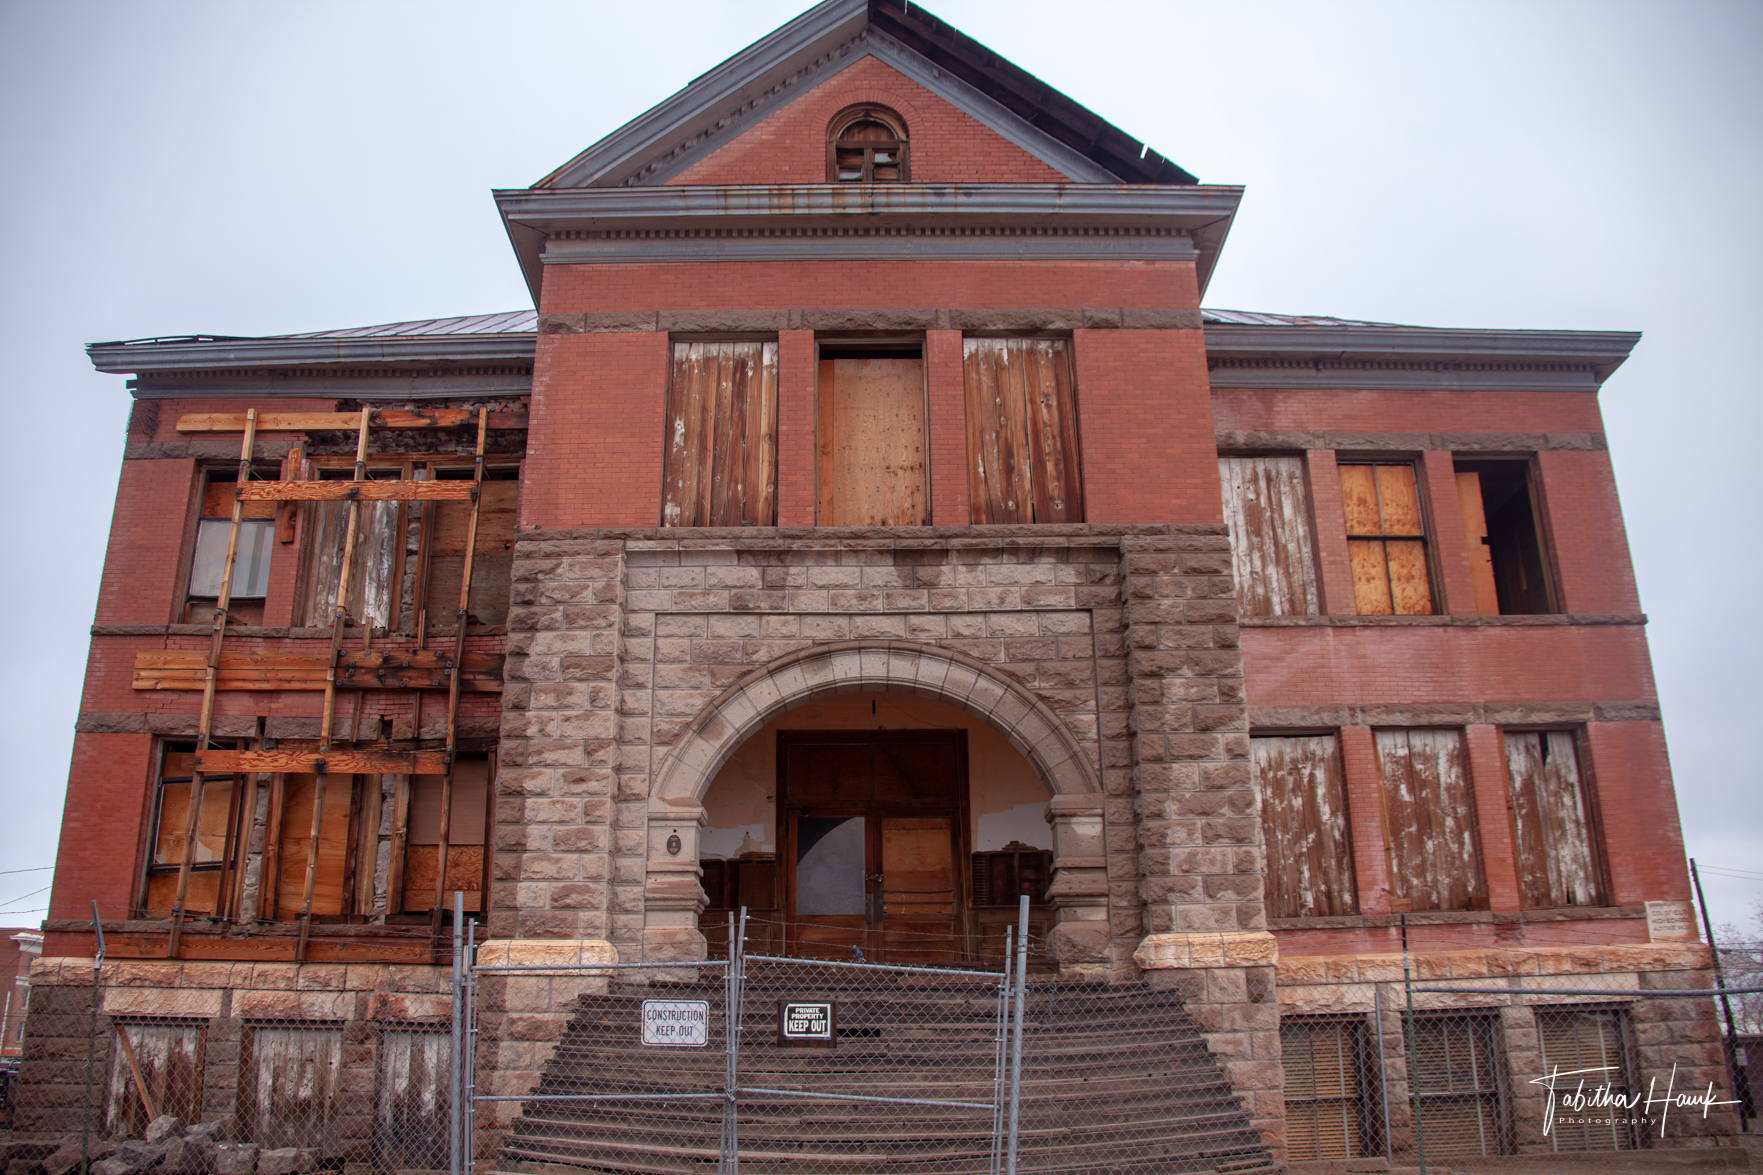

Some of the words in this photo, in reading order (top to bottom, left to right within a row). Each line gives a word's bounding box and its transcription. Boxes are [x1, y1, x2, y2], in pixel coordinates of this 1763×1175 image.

[647, 1010, 704, 1021] CONSTRUCTION
[656, 1026, 675, 1036] KEEP
[679, 1026, 693, 1036] OUT
[789, 1020, 809, 1032] KEEP
[811, 1020, 826, 1032] OUT
